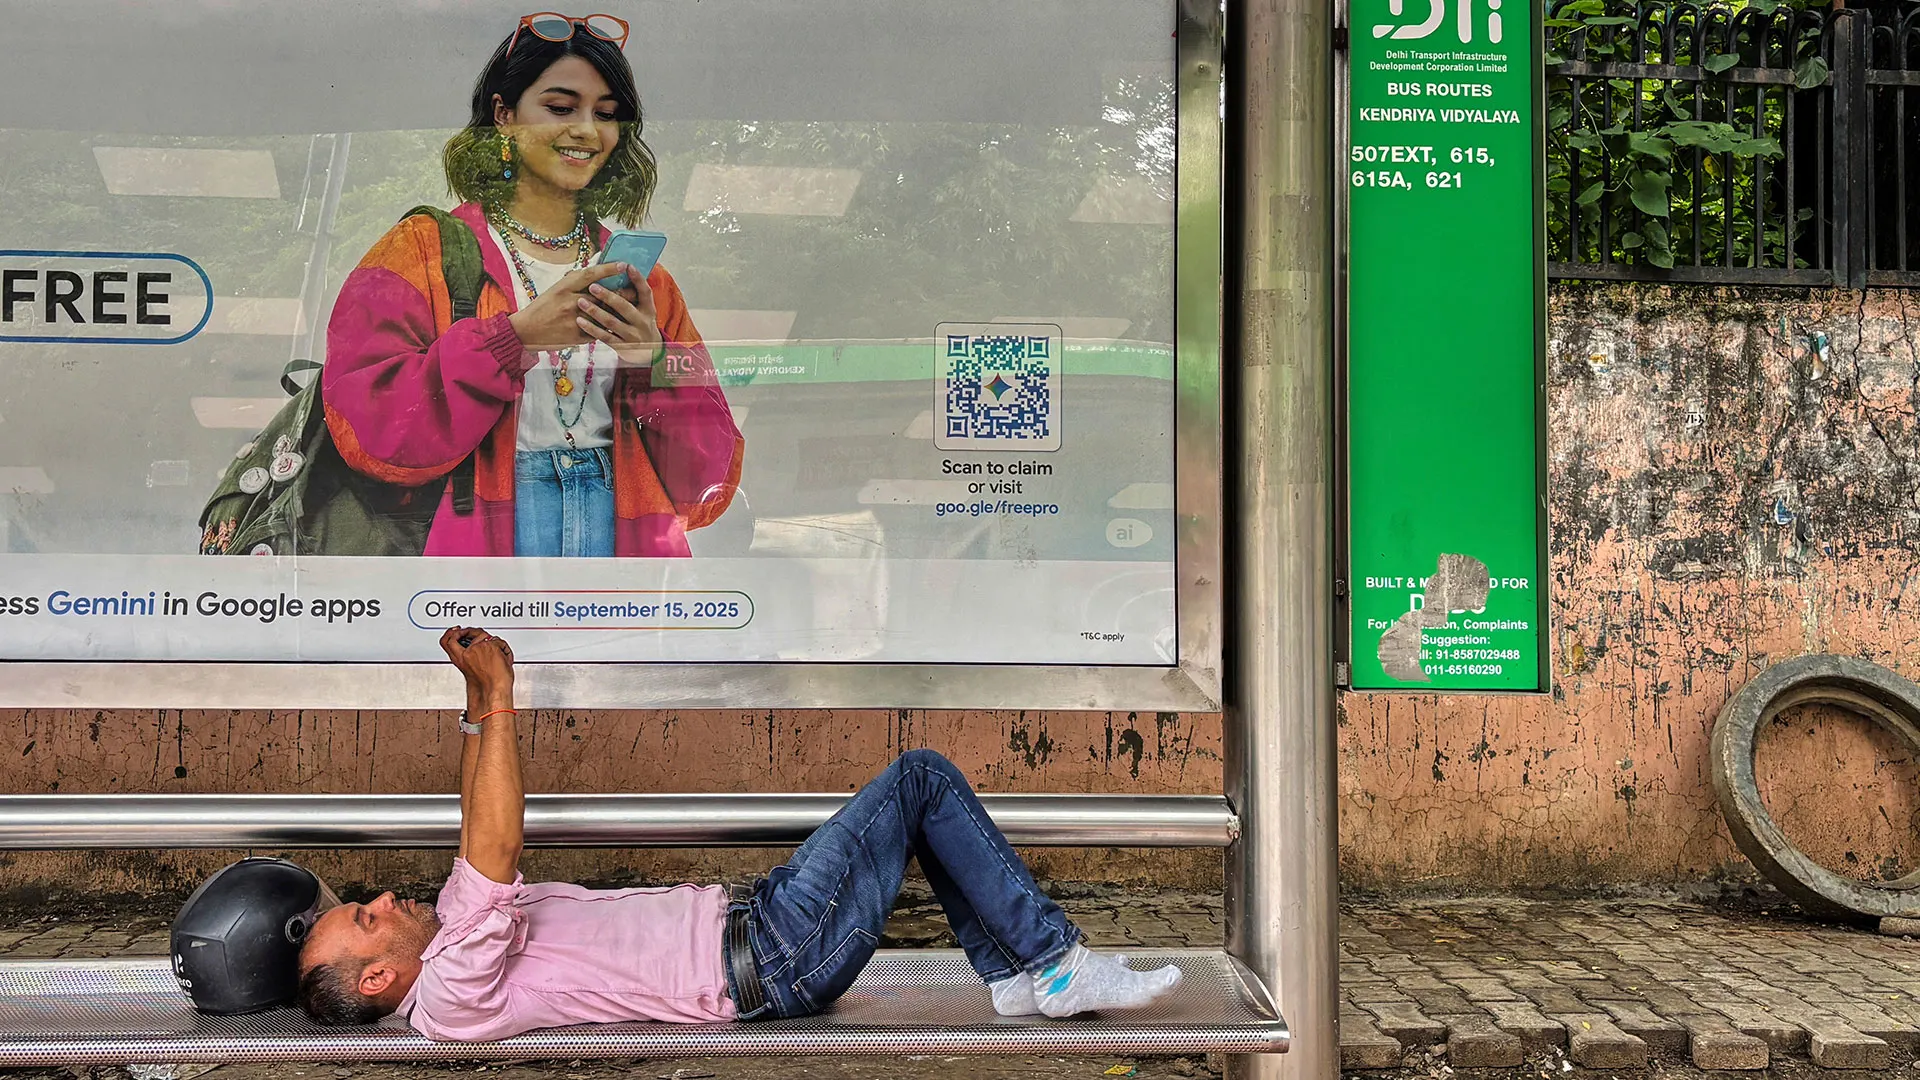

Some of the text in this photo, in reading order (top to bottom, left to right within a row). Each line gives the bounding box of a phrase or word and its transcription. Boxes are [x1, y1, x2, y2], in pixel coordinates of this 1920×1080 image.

[1386, 50, 1507, 61] Delhi Transport Infrastructure
[1370, 61, 1507, 73] Development Corporation Limited
[1387, 82, 1493, 97] BUS ROUTES
[1359, 108, 1520, 124] KENDRIYA VIDYALAYA
[1351, 146, 1495, 167] 507EXT, 615,
[1351, 171, 1462, 190] 615A, 621
[2, 269, 172, 325] FREE
[942, 459, 1053, 475] Scan to claim
[968, 480, 1023, 494] or visit
[935, 500, 1059, 517] goo.gle/freepro
[1365, 576, 1403, 588] BUILT
[1406, 577, 1416, 588] &
[1502, 578, 1529, 589] FOR
[47, 590, 155, 615] Gemini
[163, 591, 188, 615] in
[196, 592, 304, 623] Google
[310, 597, 381, 623] apps
[425, 601, 739, 622] Offer valid till September 15, 2025
[1367, 618, 1388, 629] For
[1463, 618, 1529, 632] Complaints
[1102, 633, 1125, 642] apply
[1421, 633, 1491, 647] Suggestion:
[1436, 649, 1520, 660] 91-8587029488
[1425, 664, 1502, 675] 011-65160290
